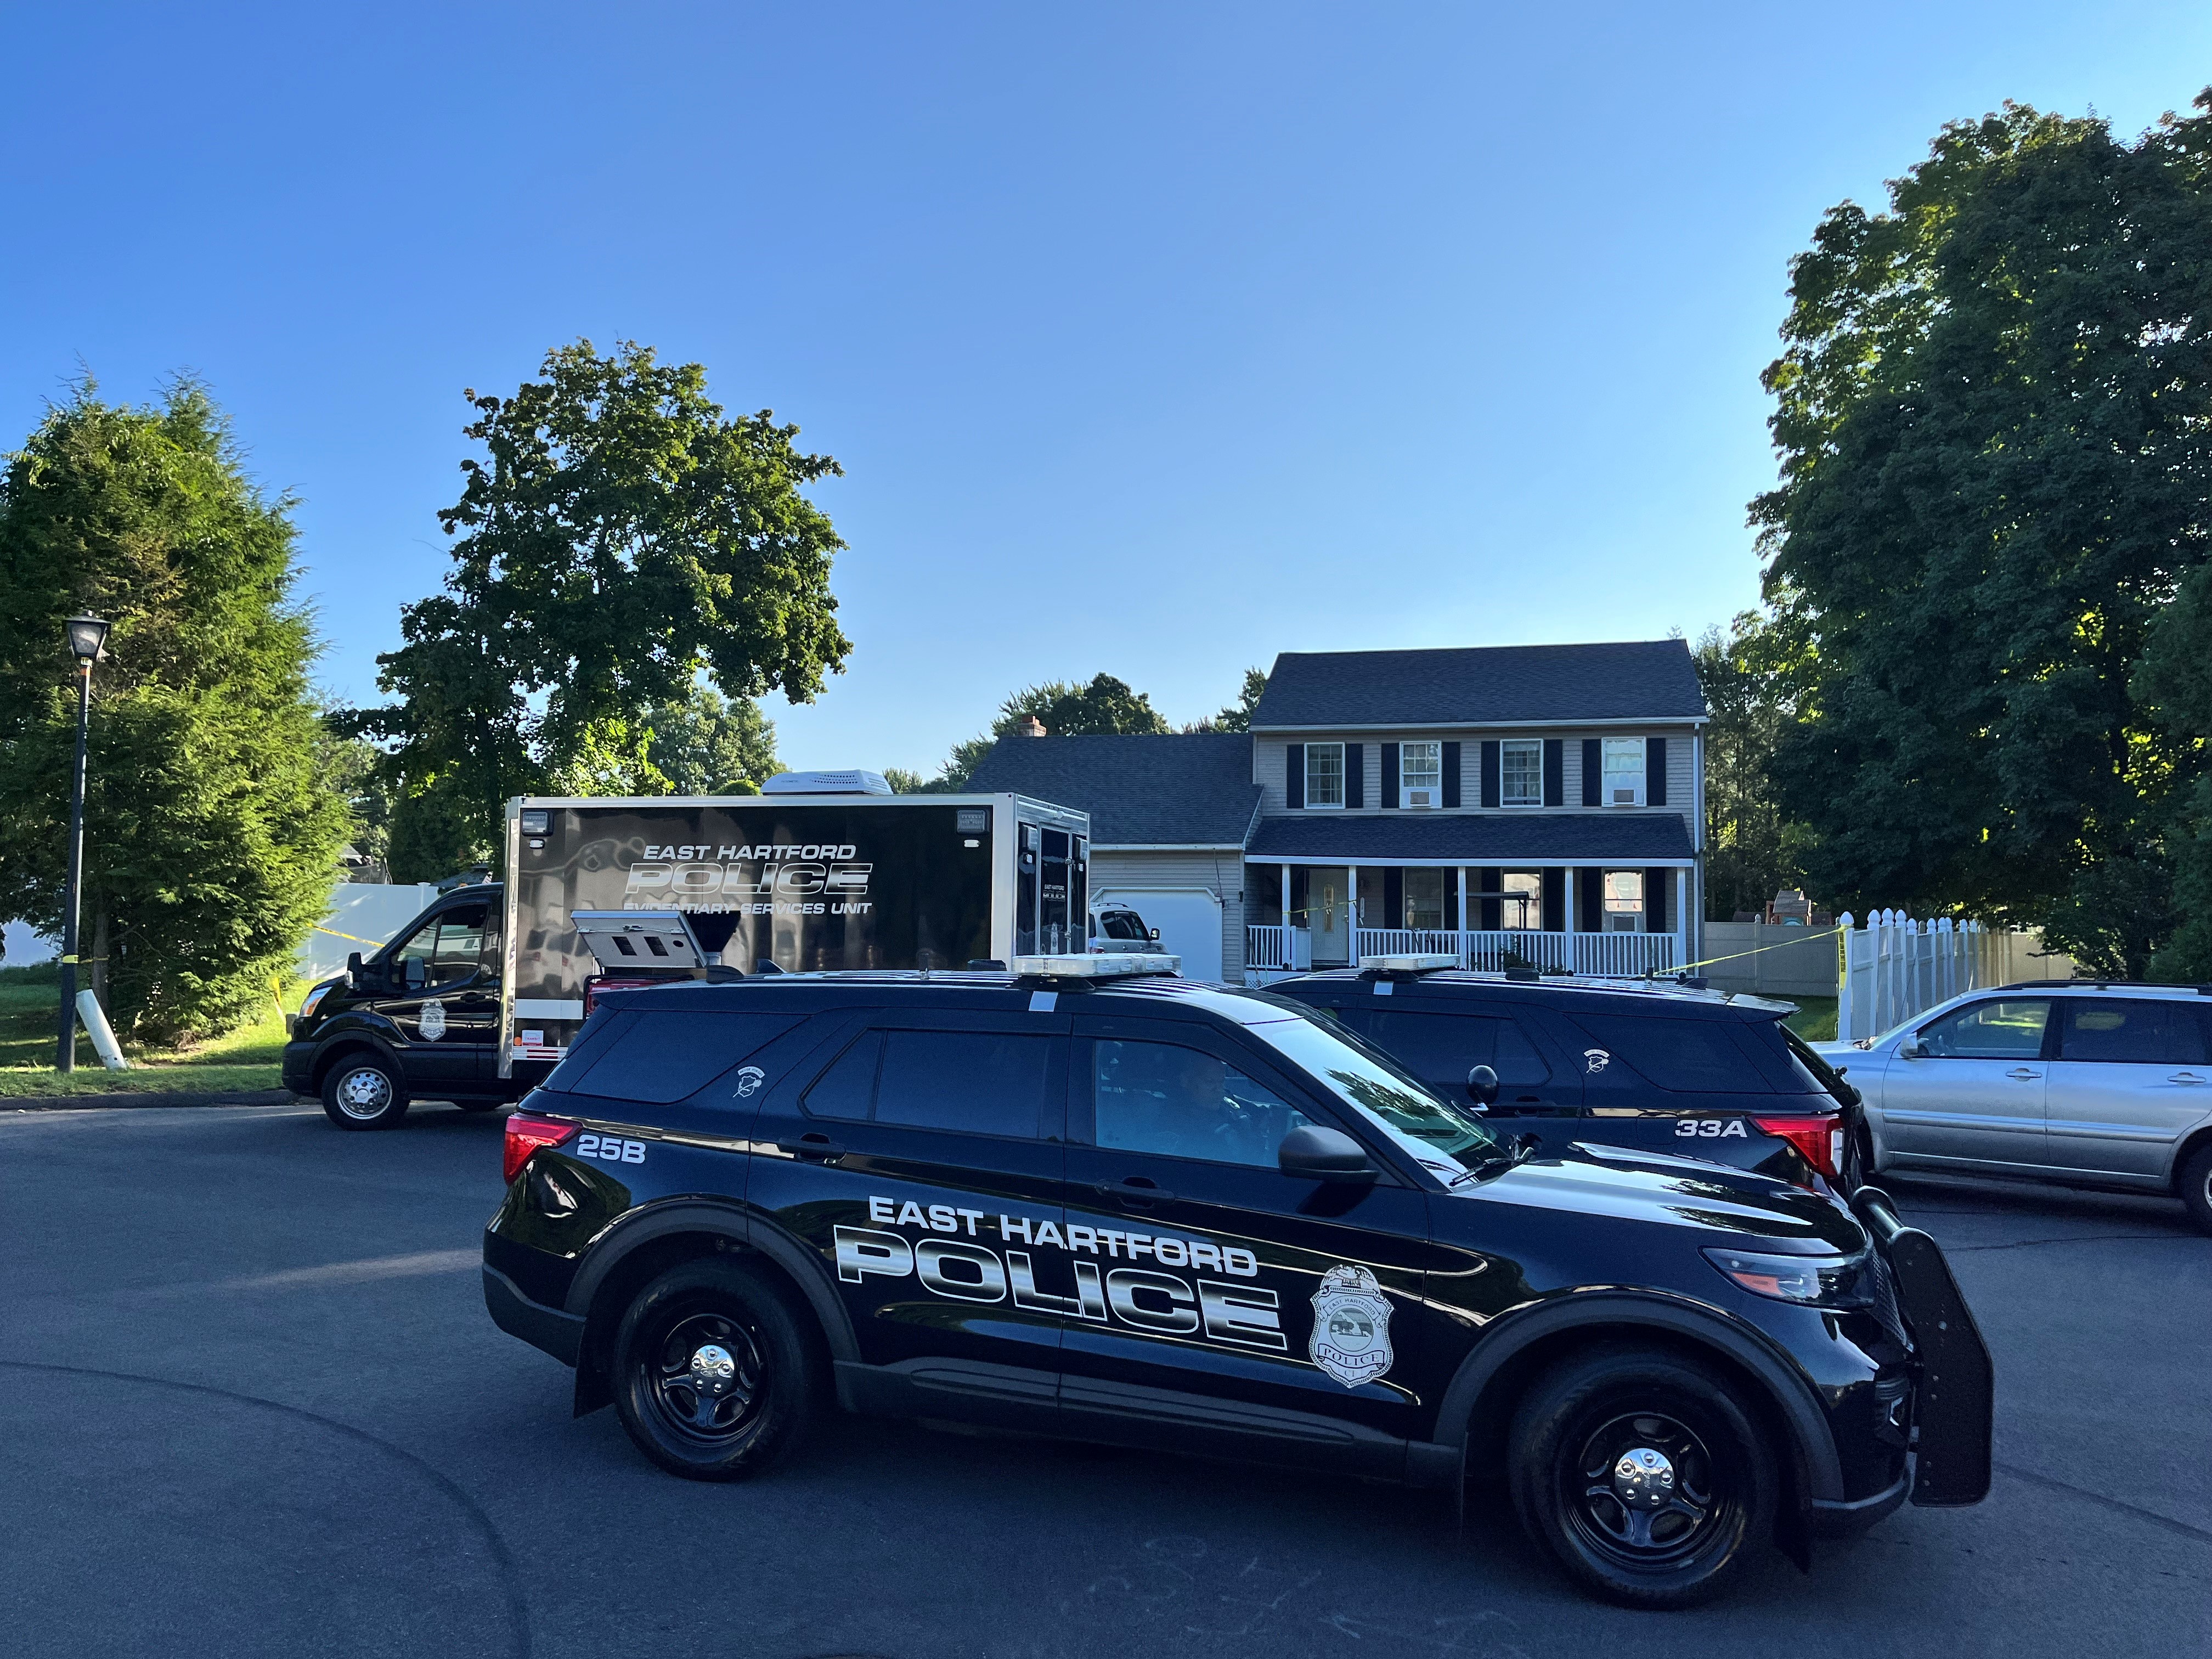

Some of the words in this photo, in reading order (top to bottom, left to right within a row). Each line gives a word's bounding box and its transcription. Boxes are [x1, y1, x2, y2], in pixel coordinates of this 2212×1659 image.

[643, 845, 710, 859] EAST
[717, 845, 856, 859] HARTFORD
[625, 862, 873, 895] POLICE
[740, 902, 825, 914] SERVICES
[831, 902, 872, 914] UNIT
[1675, 1120, 1747, 1138] 33A
[577, 1135, 646, 1164] 25B
[868, 1196, 984, 1237] EAST
[1001, 1214, 1257, 1277] HARTFORD
[833, 1224, 1288, 1351] POLICE
[1328, 1299, 1342, 1310] EAST
[1345, 1298, 1375, 1316] HARTFORD
[1324, 1348, 1380, 1365] POLICE
[1344, 1369, 1356, 1378] CT
